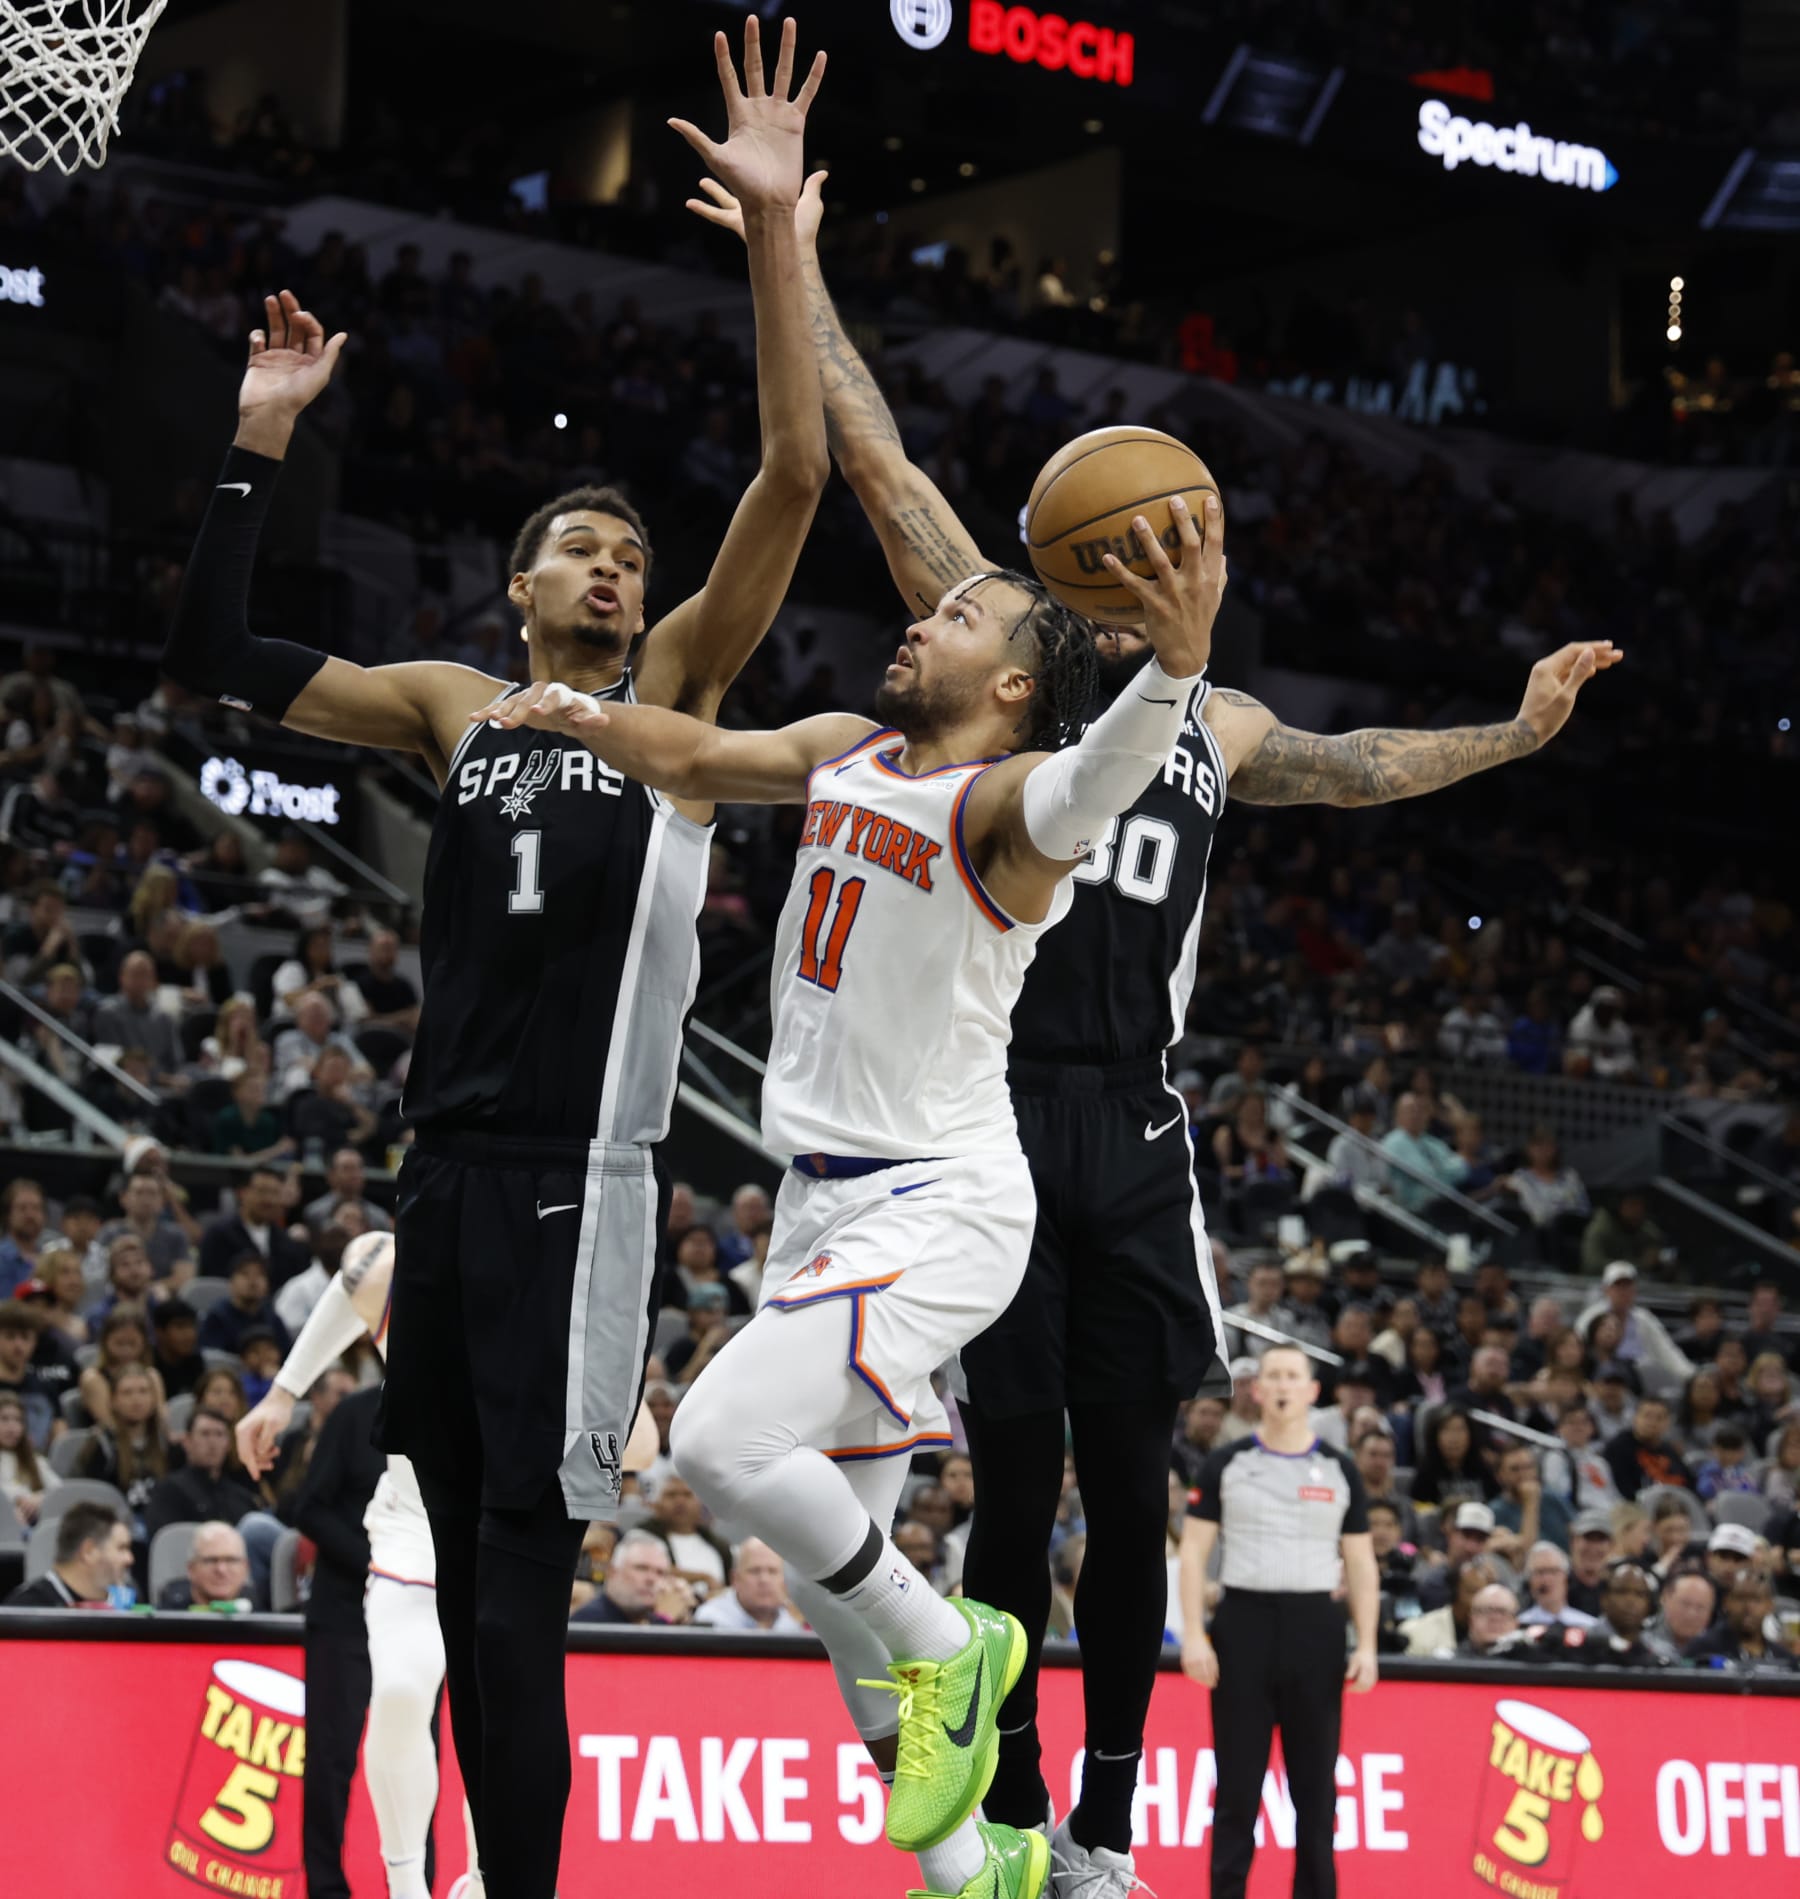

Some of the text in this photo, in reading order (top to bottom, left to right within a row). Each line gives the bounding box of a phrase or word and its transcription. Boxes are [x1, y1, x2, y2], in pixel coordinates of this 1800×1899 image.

[968, 0, 1134, 87] BOSCH
[1418, 99, 1607, 192] Spectrum
[249, 769, 340, 825] Frost
[507, 829, 545, 914] 1
[845, 805, 944, 895] YORK
[796, 866, 866, 994] 11
[201, 1683, 306, 1778] TAKE
[1489, 1720, 1577, 1803] TAKE
[199, 1762, 280, 1856] 5
[579, 1734, 885, 1845] TAKE 5
[1493, 1787, 1551, 1868] 5
[1656, 1758, 1800, 1858] OFFI
[169, 1840, 199, 1875] OIL
